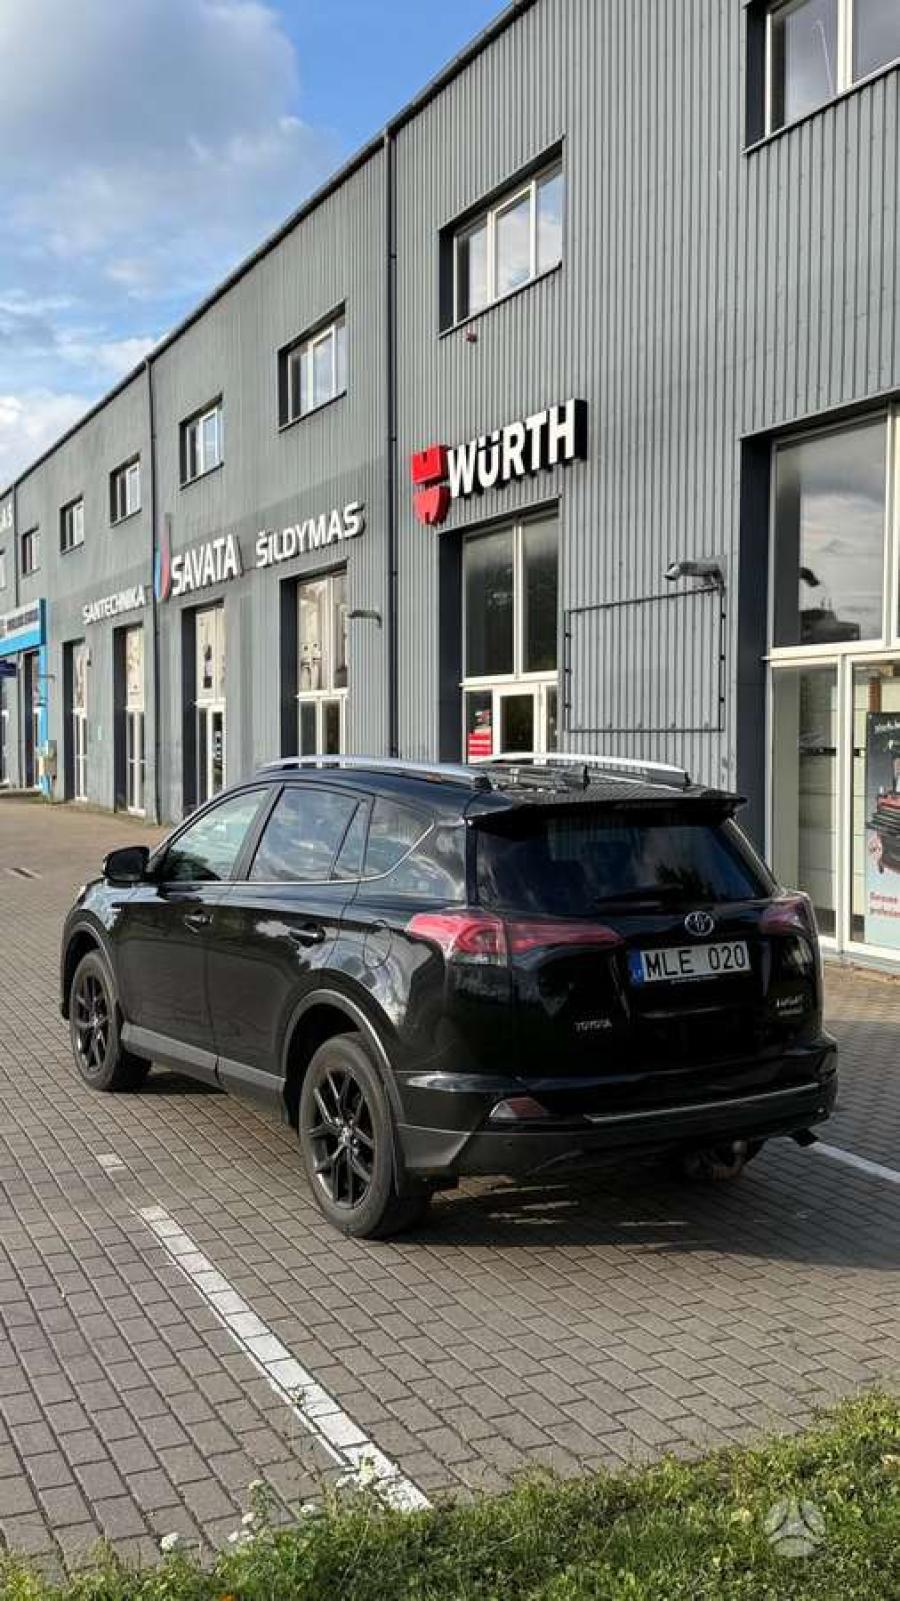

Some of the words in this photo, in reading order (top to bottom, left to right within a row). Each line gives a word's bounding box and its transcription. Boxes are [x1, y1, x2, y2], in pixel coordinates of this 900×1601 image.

[447, 398, 576, 498] WÜRTH
[171, 533, 242, 597] SAVATA
[255, 500, 363, 568] ŠILDYMAS
[82, 583, 145, 624] SANTECHNIKA
[644, 950, 694, 978] MLE
[708, 944, 746, 970] 020
